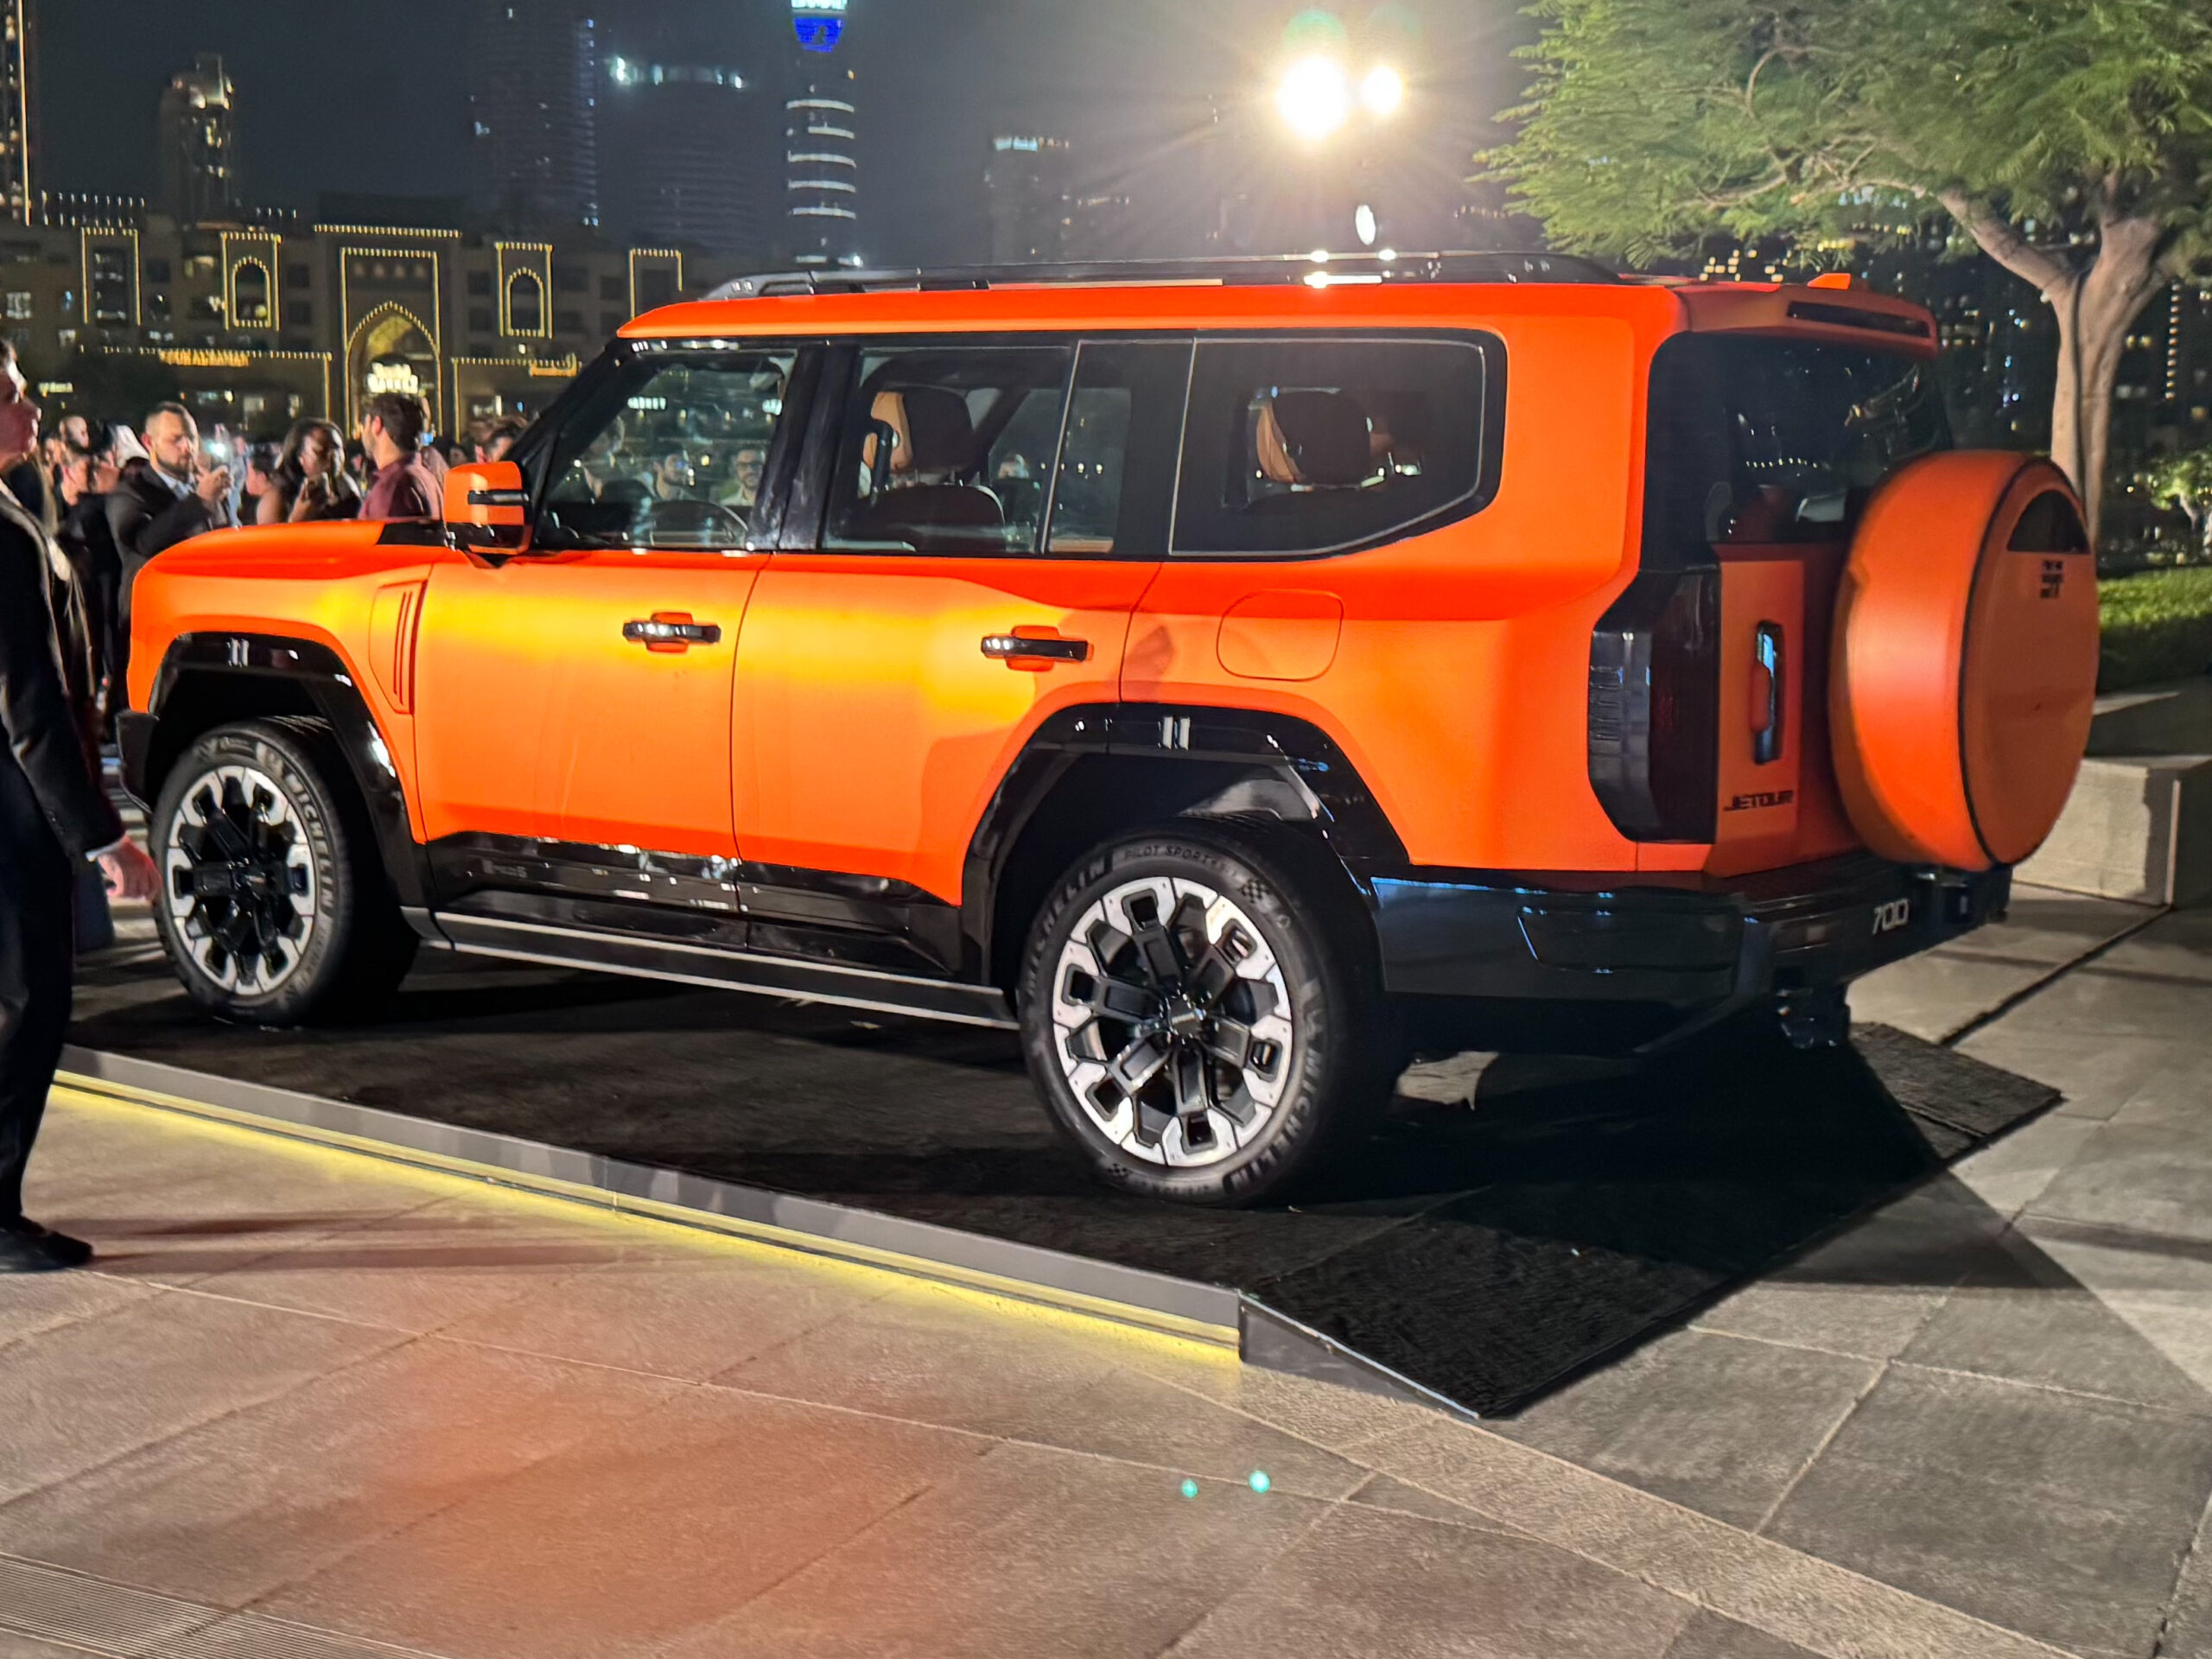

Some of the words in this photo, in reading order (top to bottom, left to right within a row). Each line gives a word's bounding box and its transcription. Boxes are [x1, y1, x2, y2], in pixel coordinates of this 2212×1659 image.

[1725, 790, 1794, 810] JETOUR
[1165, 845, 1210, 864] SPORT
[1872, 898, 1909, 934] 700
